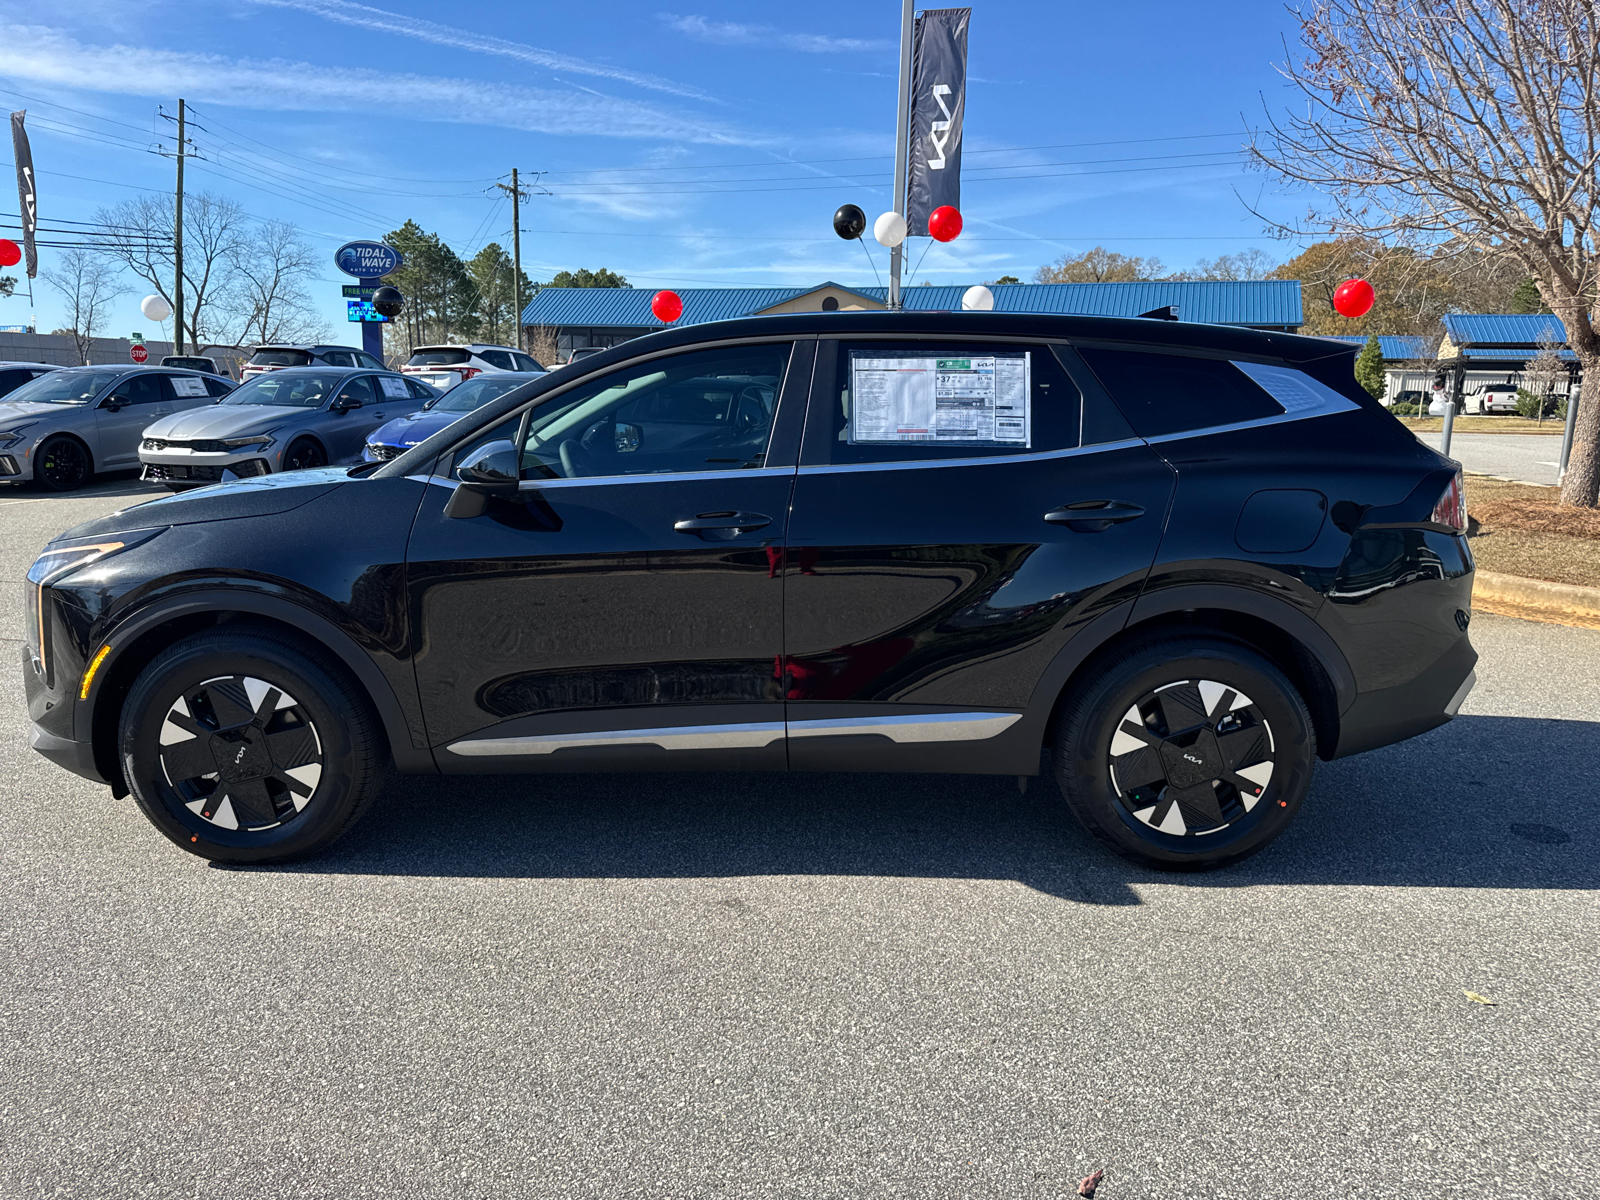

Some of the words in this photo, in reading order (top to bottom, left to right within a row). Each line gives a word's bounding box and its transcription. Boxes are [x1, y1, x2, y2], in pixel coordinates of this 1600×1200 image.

[356, 248, 385, 257] TIDAL
[362, 258, 391, 267] WAVE
[344, 287, 360, 295] FREE
[131, 350, 147, 358] STOP
[940, 375, 950, 383] 37
[1183, 753, 1203, 764] KIA
